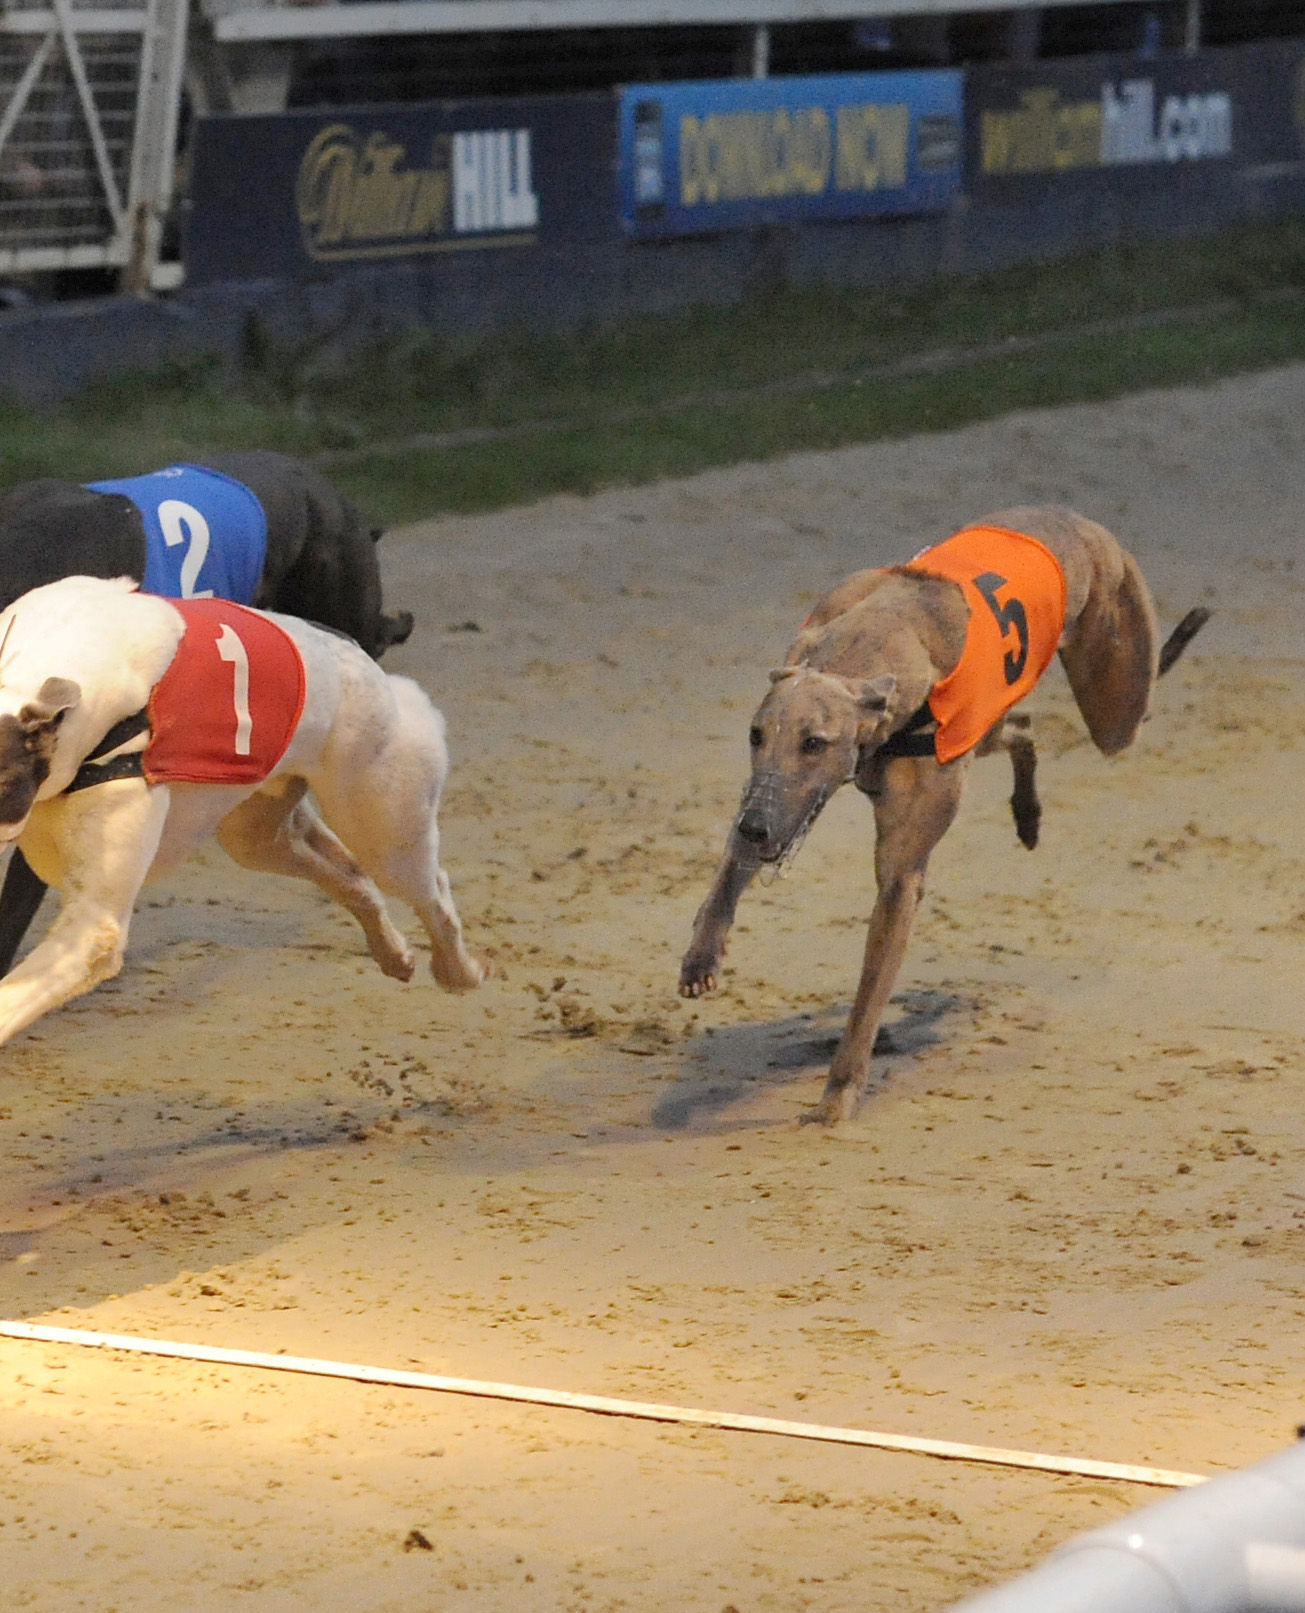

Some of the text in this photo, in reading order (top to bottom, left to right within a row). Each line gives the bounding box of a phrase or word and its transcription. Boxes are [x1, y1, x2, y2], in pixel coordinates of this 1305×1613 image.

[453, 128, 539, 232] HILL
[157, 499, 214, 600] 2
[971, 571, 1029, 686] 5
[215, 623, 253, 755] 1
